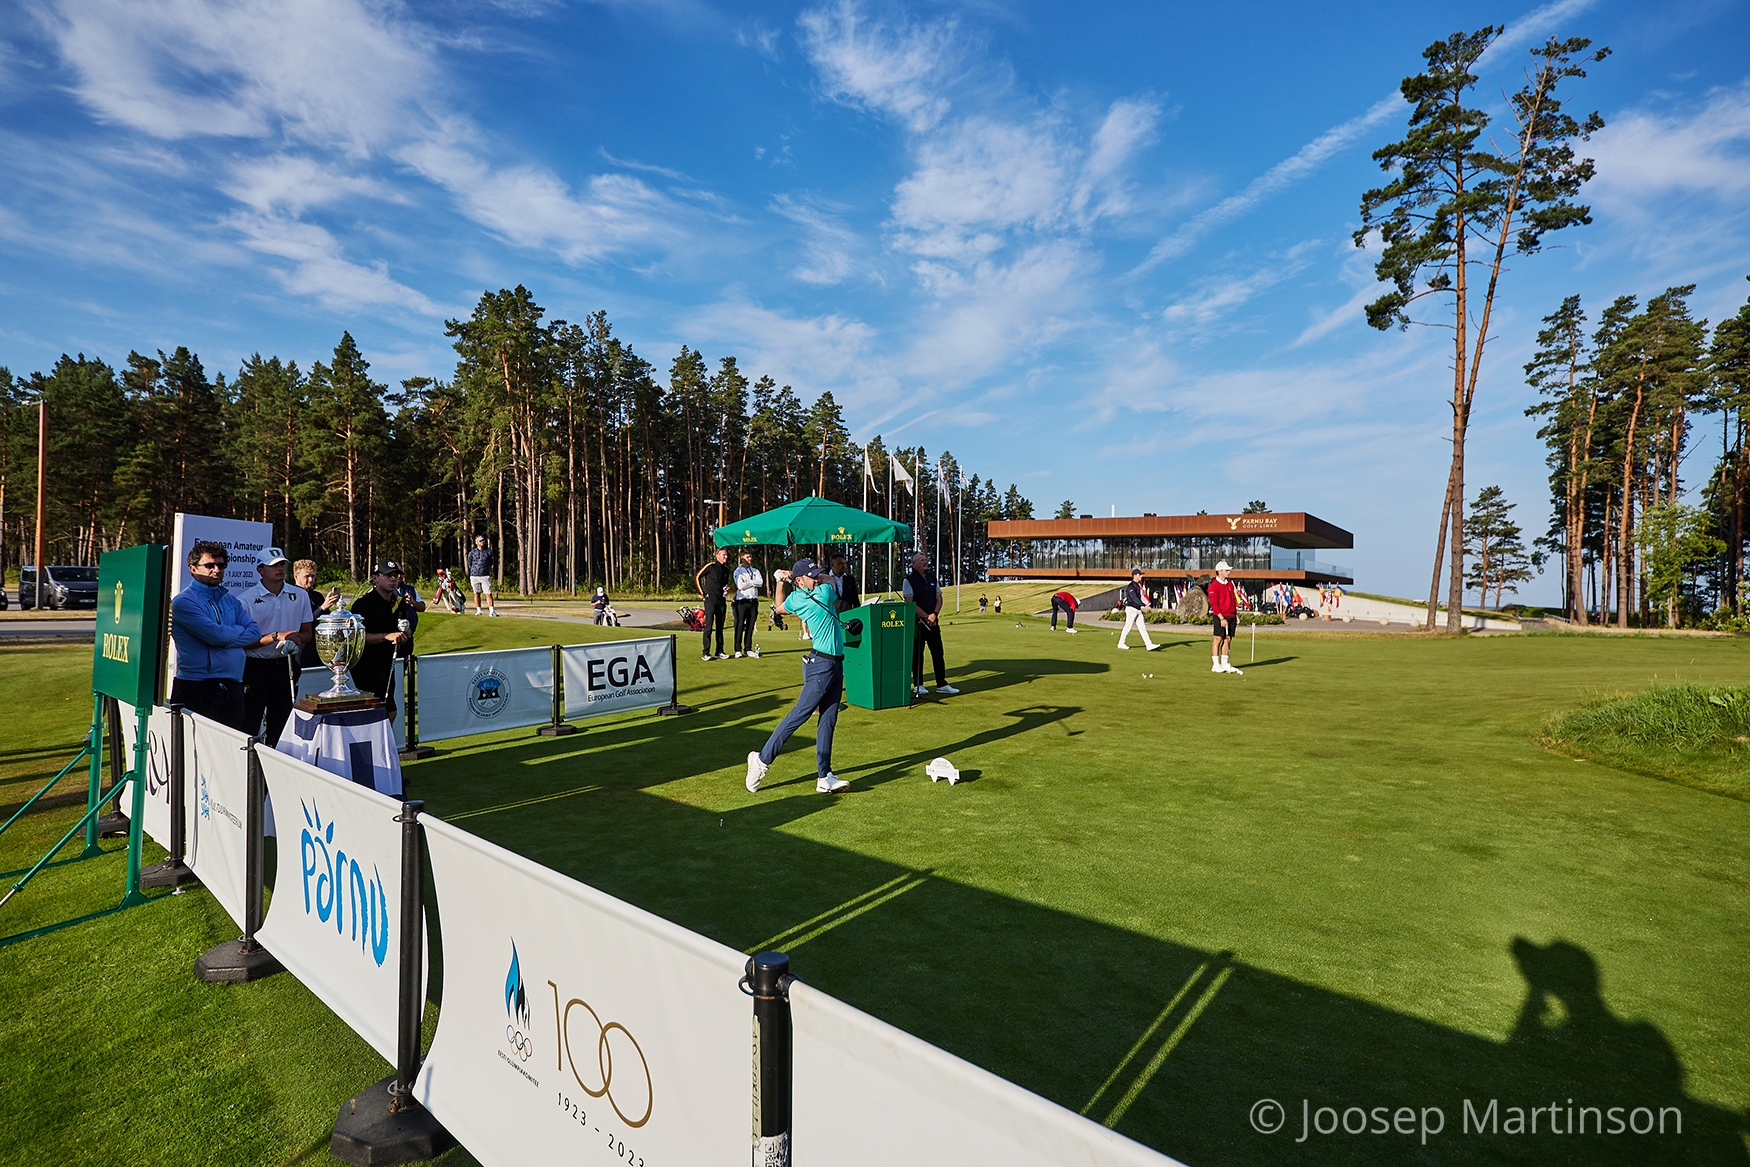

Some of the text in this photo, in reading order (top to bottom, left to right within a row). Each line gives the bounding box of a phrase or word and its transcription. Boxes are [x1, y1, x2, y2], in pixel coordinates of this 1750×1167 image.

[233, 541, 264, 551] Amateur
[227, 553, 256, 565] pionship
[881, 620, 904, 628] ROLEX
[102, 632, 130, 663] ROLEX
[587, 655, 655, 691] EGA
[588, 685, 656, 702] European Golf Association
[547, 979, 653, 1129] 100
[558, 1092, 587, 1126] 1923
[608, 1133, 645, 1167] 2023
